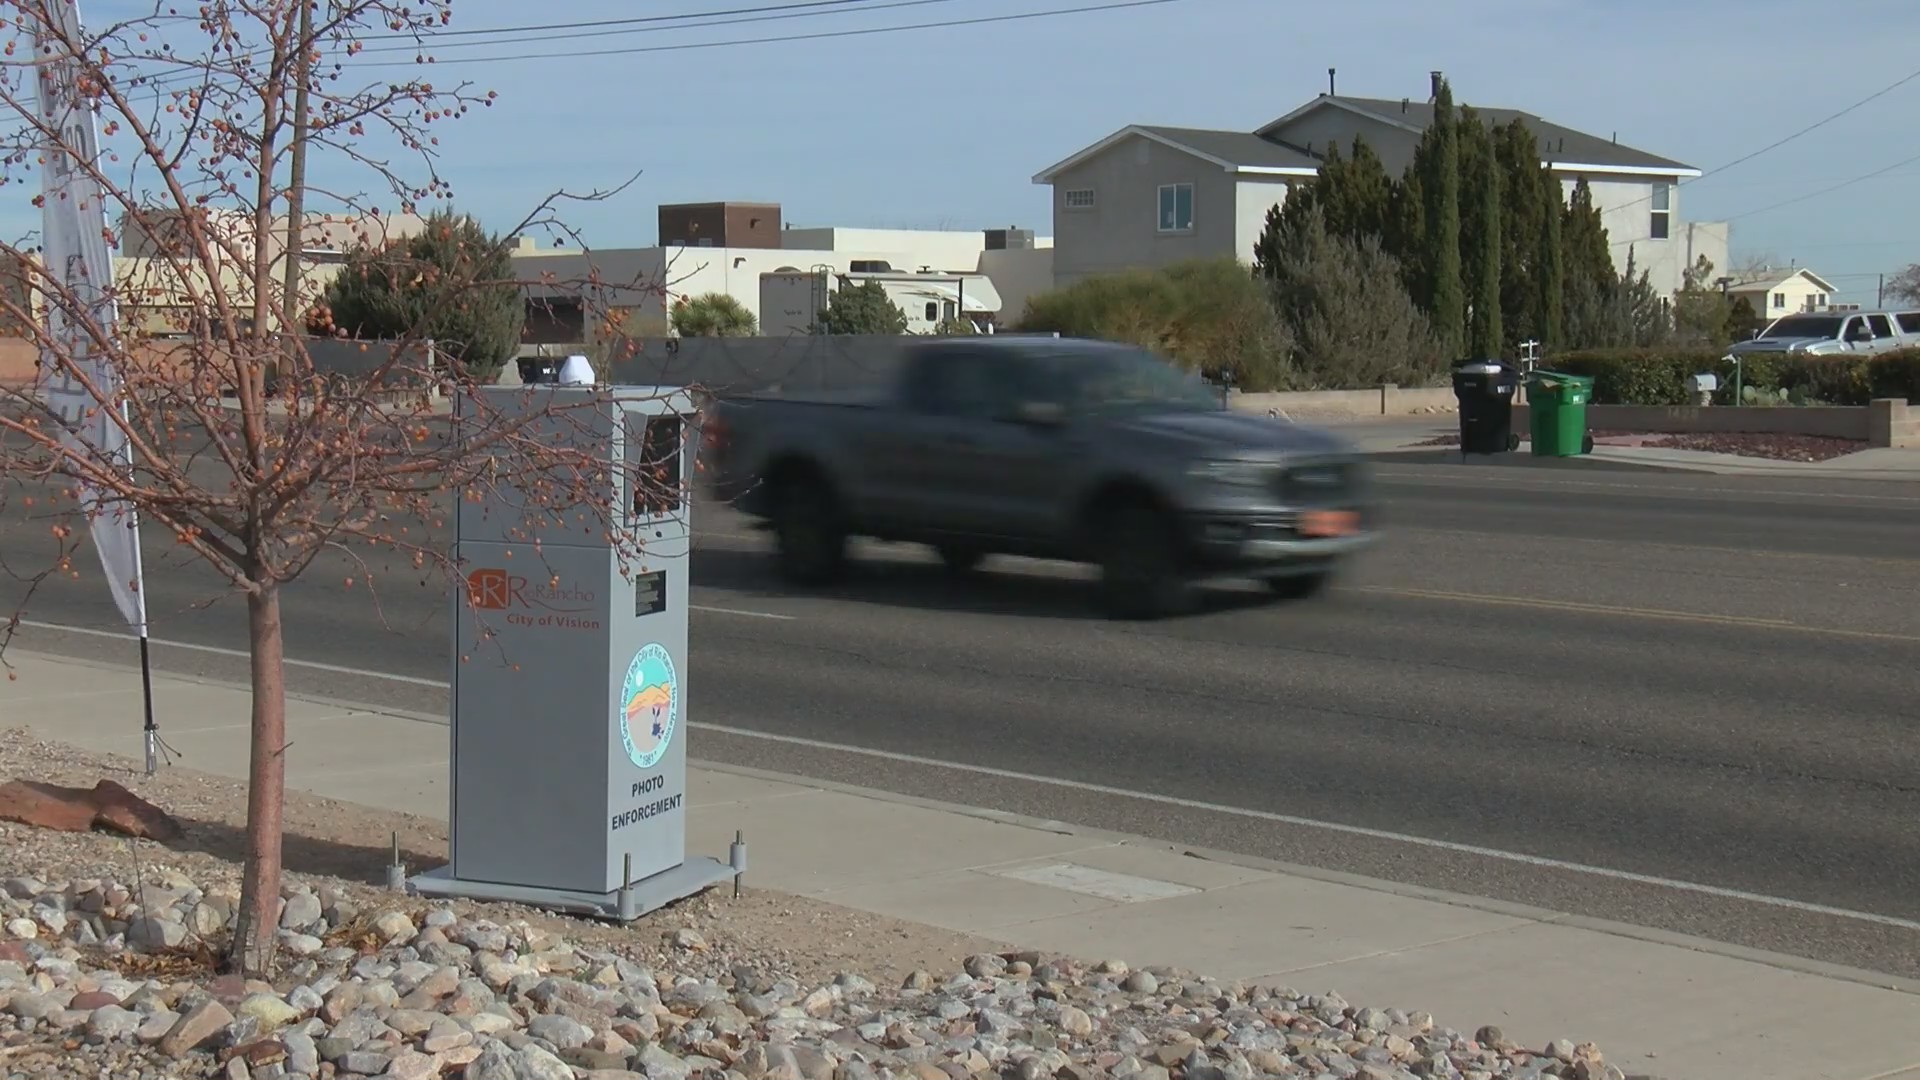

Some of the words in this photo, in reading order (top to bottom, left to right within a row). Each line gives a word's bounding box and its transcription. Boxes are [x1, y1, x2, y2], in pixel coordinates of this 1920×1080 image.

[535, 582, 595, 602] Rancho
[507, 614, 534, 626] City
[538, 615, 552, 624] of
[556, 616, 600, 629] Vision
[638, 649, 648, 663] City
[632, 774, 664, 797] PHOTO
[612, 793, 682, 830] ENFORCEMENT
